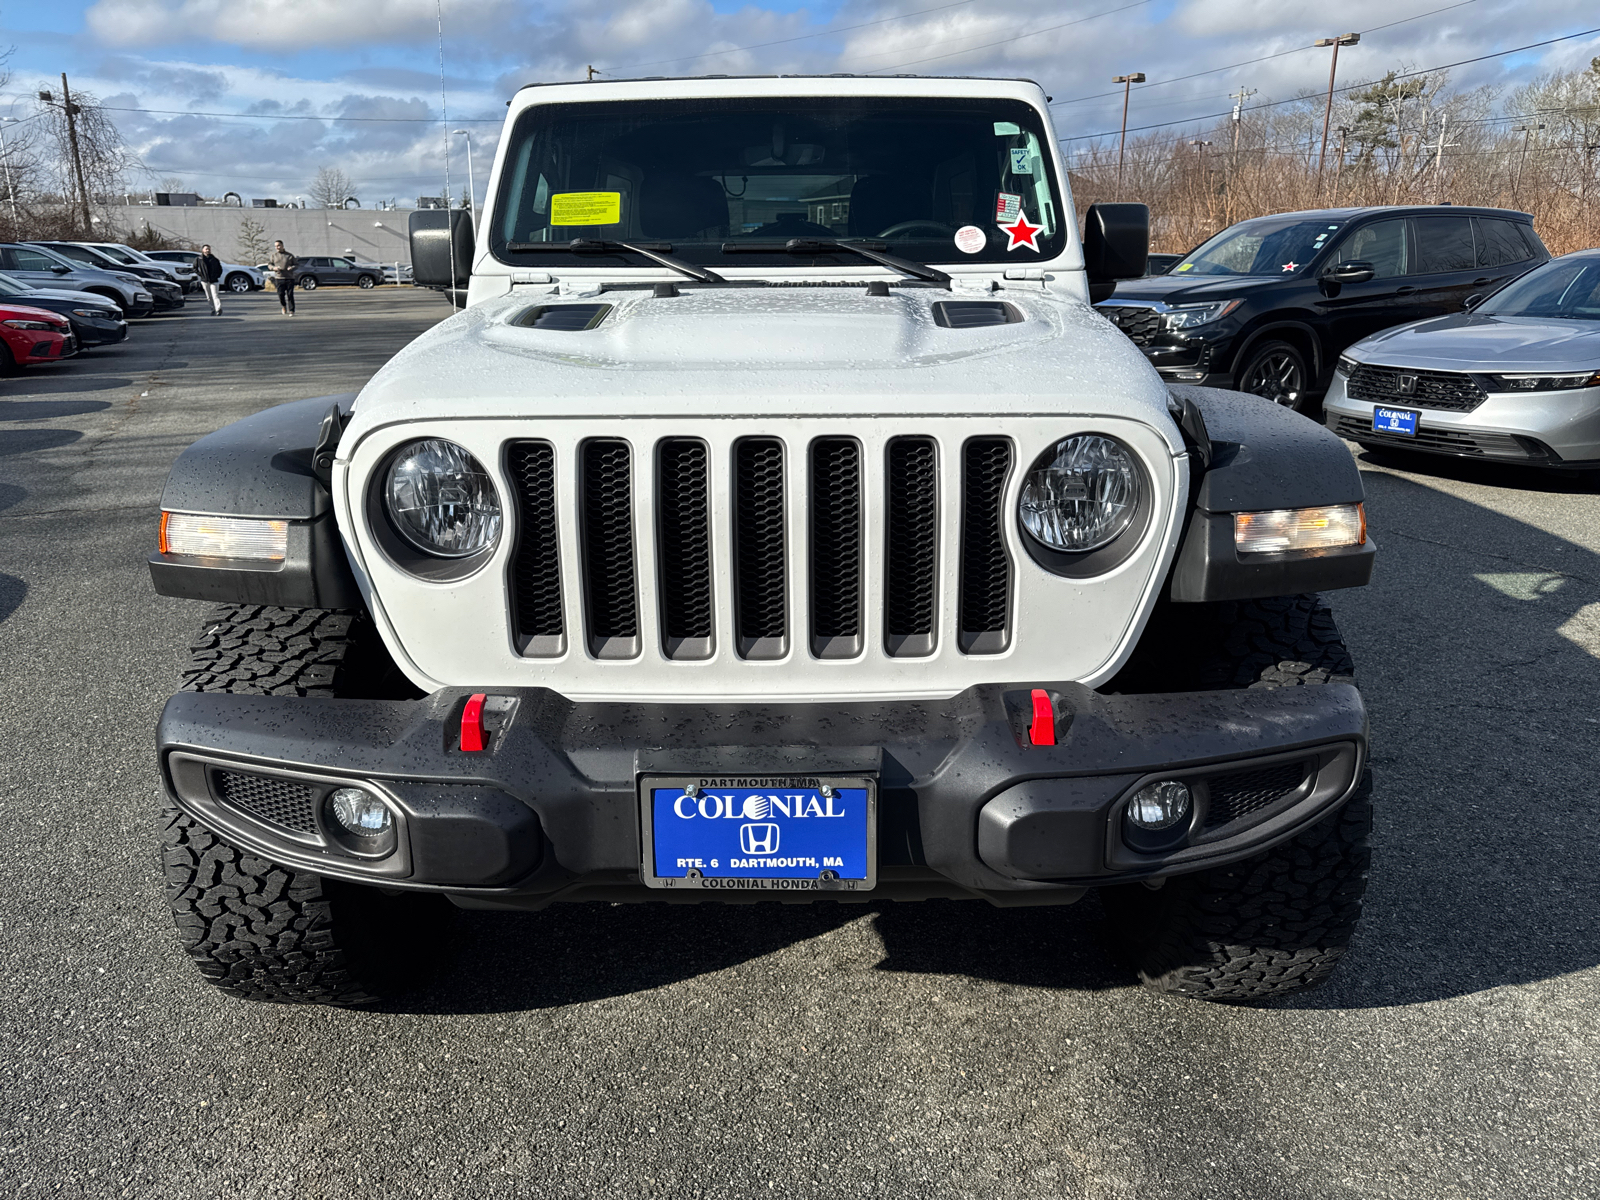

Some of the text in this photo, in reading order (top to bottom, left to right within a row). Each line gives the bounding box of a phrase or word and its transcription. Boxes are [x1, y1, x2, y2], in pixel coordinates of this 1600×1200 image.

[1378, 410, 1413, 421] COLONIAL
[699, 778, 787, 788] DARTMOUTH
[673, 794, 845, 820] COLONIAL
[676, 857, 844, 869] RTE. 6 DARTMOUTH, MA
[701, 878, 819, 890] COLONIAL HONDA
